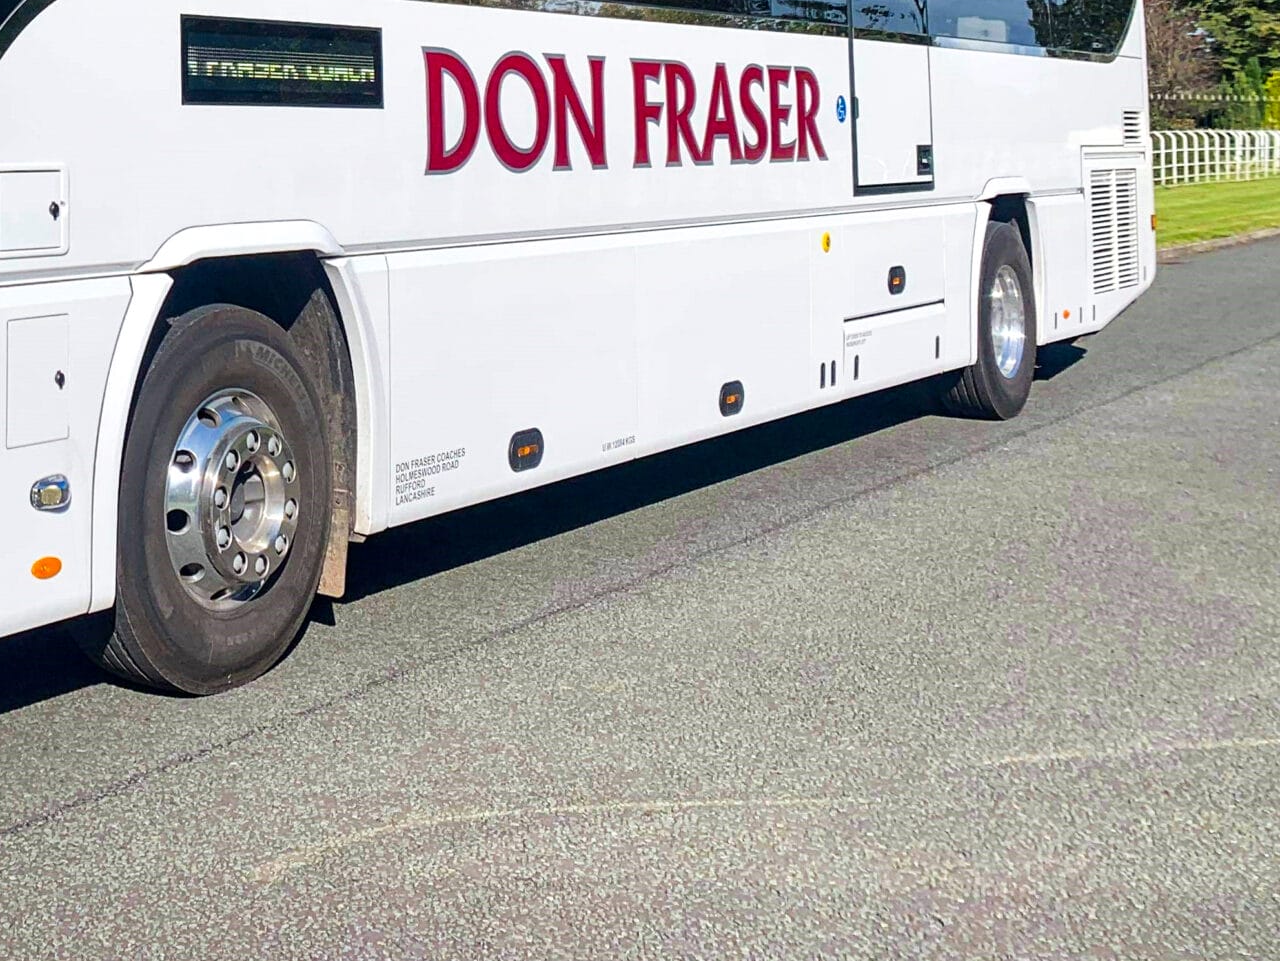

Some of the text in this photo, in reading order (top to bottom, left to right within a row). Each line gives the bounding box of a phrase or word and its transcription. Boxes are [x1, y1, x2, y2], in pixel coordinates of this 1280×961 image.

[421, 46, 828, 176] DON FRASER
[395, 447, 466, 473] DON FRASER COACHES
[395, 460, 460, 484] HOLMESWOOD ROAD
[395, 479, 426, 495] RUFFORD
[395, 486, 436, 506] LANCASHIRE
